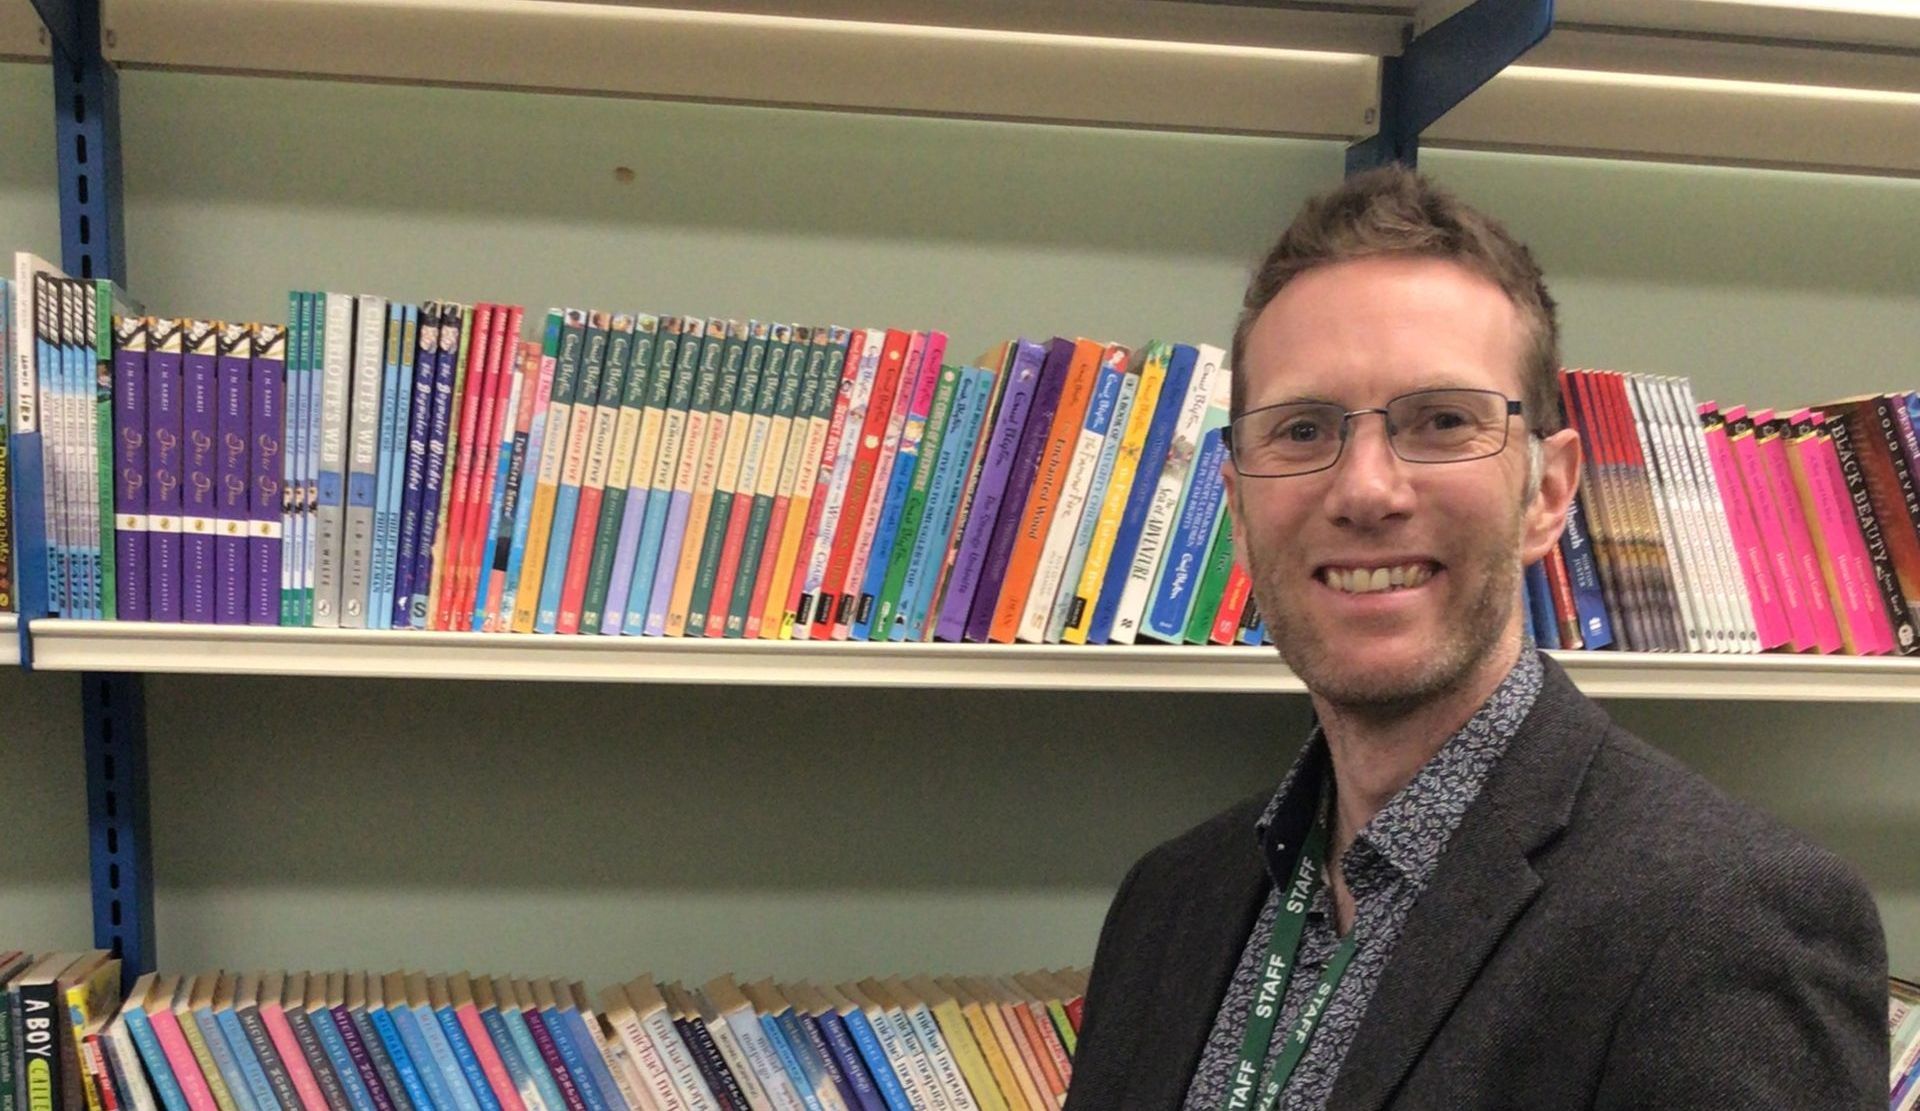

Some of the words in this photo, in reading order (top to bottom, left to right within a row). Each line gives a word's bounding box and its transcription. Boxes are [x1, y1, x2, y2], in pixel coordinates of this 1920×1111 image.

[37, 276, 48, 339] EDGE
[48, 282, 59, 344] EDGE
[62, 282, 72, 344] EDGE
[74, 283, 84, 346] EDGE
[87, 285, 96, 346] EDGE
[325, 306, 345, 421] CHARLOTTE'S
[564, 334, 578, 361] Enid
[589, 336, 604, 363] Enid
[611, 338, 627, 365] Enid
[635, 339, 650, 366] Enid
[660, 340, 676, 366] Enid
[682, 342, 697, 368] Enid
[704, 343, 720, 370] Enid
[727, 345, 742, 372] Enid
[748, 345, 764, 372] Enid
[768, 348, 784, 375] Enid
[789, 349, 804, 376] Enid
[360, 308, 380, 423] CHARLOTTE'S
[809, 351, 824, 377] Enid
[827, 351, 843, 377] Enid
[1197, 362, 1215, 391] Enid
[127, 381, 135, 410] BARRIE
[558, 364, 574, 397] Blyton
[583, 366, 600, 398] Blyton
[605, 368, 622, 400] Blyton
[629, 369, 646, 401] Blyton
[654, 370, 670, 402] Blyton
[675, 372, 692, 404] Blyton
[697, 373, 714, 405] Blyton
[719, 375, 736, 406] Blyton
[741, 375, 758, 406] Blyton
[762, 378, 779, 409] Blyton
[782, 379, 798, 410] Blyton
[801, 380, 818, 411] Blyton
[819, 380, 837, 411] Blyton
[1100, 374, 1117, 398] Enid
[161, 384, 169, 411] BARRIE
[196, 385, 204, 413] BARRIE
[230, 388, 238, 416] BARRIE
[264, 390, 272, 417] BARRIE
[1007, 392, 1025, 423] Enid
[1186, 394, 1205, 429] Blyton
[831, 404, 848, 435] SECRET
[950, 403, 966, 433] Blyton
[1093, 400, 1112, 428] Blyton
[1113, 401, 1127, 427] BOOK
[123, 428, 142, 463] Peter
[157, 428, 176, 464] Peter
[324, 428, 340, 462] WEB
[357, 430, 374, 464] WEB
[515, 436, 525, 453] The
[573, 410, 587, 453] FAMOUS
[595, 413, 609, 455] FAMOUS
[664, 415, 679, 457] FAMOUS
[687, 416, 700, 458] FAMOUS
[707, 418, 722, 460] FAMOUS
[807, 423, 823, 465] FAMOUS
[994, 428, 1017, 466] Blyton
[1112, 429, 1120, 440] OF
[192, 430, 210, 466] Peter
[225, 433, 244, 468] Peter
[259, 434, 277, 470] Peter
[824, 436, 840, 461] SEVEN
[939, 451, 950, 474] FIVE
[1877, 406, 1898, 452] GOLD
[1894, 459, 1920, 514] FEVER
[408, 440, 425, 490] Witches
[426, 440, 444, 490] Witches
[508, 455, 524, 486] Secret
[569, 456, 579, 481] FIVE
[591, 458, 602, 483] FIVE
[659, 461, 671, 485] FIVE
[681, 463, 693, 486] FIVE
[702, 463, 714, 487] FIVE
[800, 467, 812, 492] FIVE
[1039, 438, 1066, 500] Enchanted
[1094, 444, 1117, 492] NAUGHTY
[124, 468, 142, 500] Pan
[157, 470, 176, 500] Pan
[192, 472, 210, 503] Pan
[225, 474, 244, 506] Pan
[259, 475, 277, 507] Pan
[930, 493, 940, 504] TO
[936, 475, 944, 490] GO
[1157, 488, 1172, 504] Sea
[1830, 424, 1862, 485] BLACK
[1854, 491, 1887, 562] BEAUTY
[504, 489, 518, 518] Seven
[905, 497, 920, 524] Enid
[984, 496, 995, 510] The
[1166, 498, 1176, 509] The
[376, 512, 385, 542] PHILIP
[387, 512, 398, 545] PHILIP
[912, 507, 936, 567] SMUGGLER'S
[973, 514, 990, 548] Strange
[1028, 505, 1046, 540] Wood
[1079, 495, 1099, 547] CHILDREN
[894, 528, 914, 566] Blyton
[1132, 518, 1163, 582] ADVENTURE
[1175, 553, 1193, 573] Enid
[322, 550, 330, 585] WHITE
[352, 550, 362, 586] WHITE
[373, 548, 383, 593] PULLMAN
[384, 549, 396, 593] PULLMAN
[811, 552, 827, 583] CHAIR
[908, 569, 918, 587] TOP
[958, 552, 981, 594] Umbrella
[1574, 558, 1586, 587] JUSTER
[1580, 553, 1594, 587] NORTON
[1169, 572, 1186, 600] Blyton
[414, 602, 426, 618] S
[1287, 856, 1316, 914] STAFF
[1256, 954, 1286, 1018] STAFF
[24, 1000, 50, 1012] A
[1296, 982, 1332, 1044] STAFF
[26, 1018, 52, 1056] BOY
[626, 1022, 666, 1076] michael
[652, 1018, 690, 1072] michael
[694, 1021, 725, 1076] MICHAEL
[874, 1017, 903, 1062] michael
[893, 1012, 921, 1057] michael
[917, 1011, 946, 1056] michael
[938, 1056, 970, 1110] morpurgo
[31, 1068, 50, 1111] CALLE
[1228, 1060, 1256, 1111] TAFF
